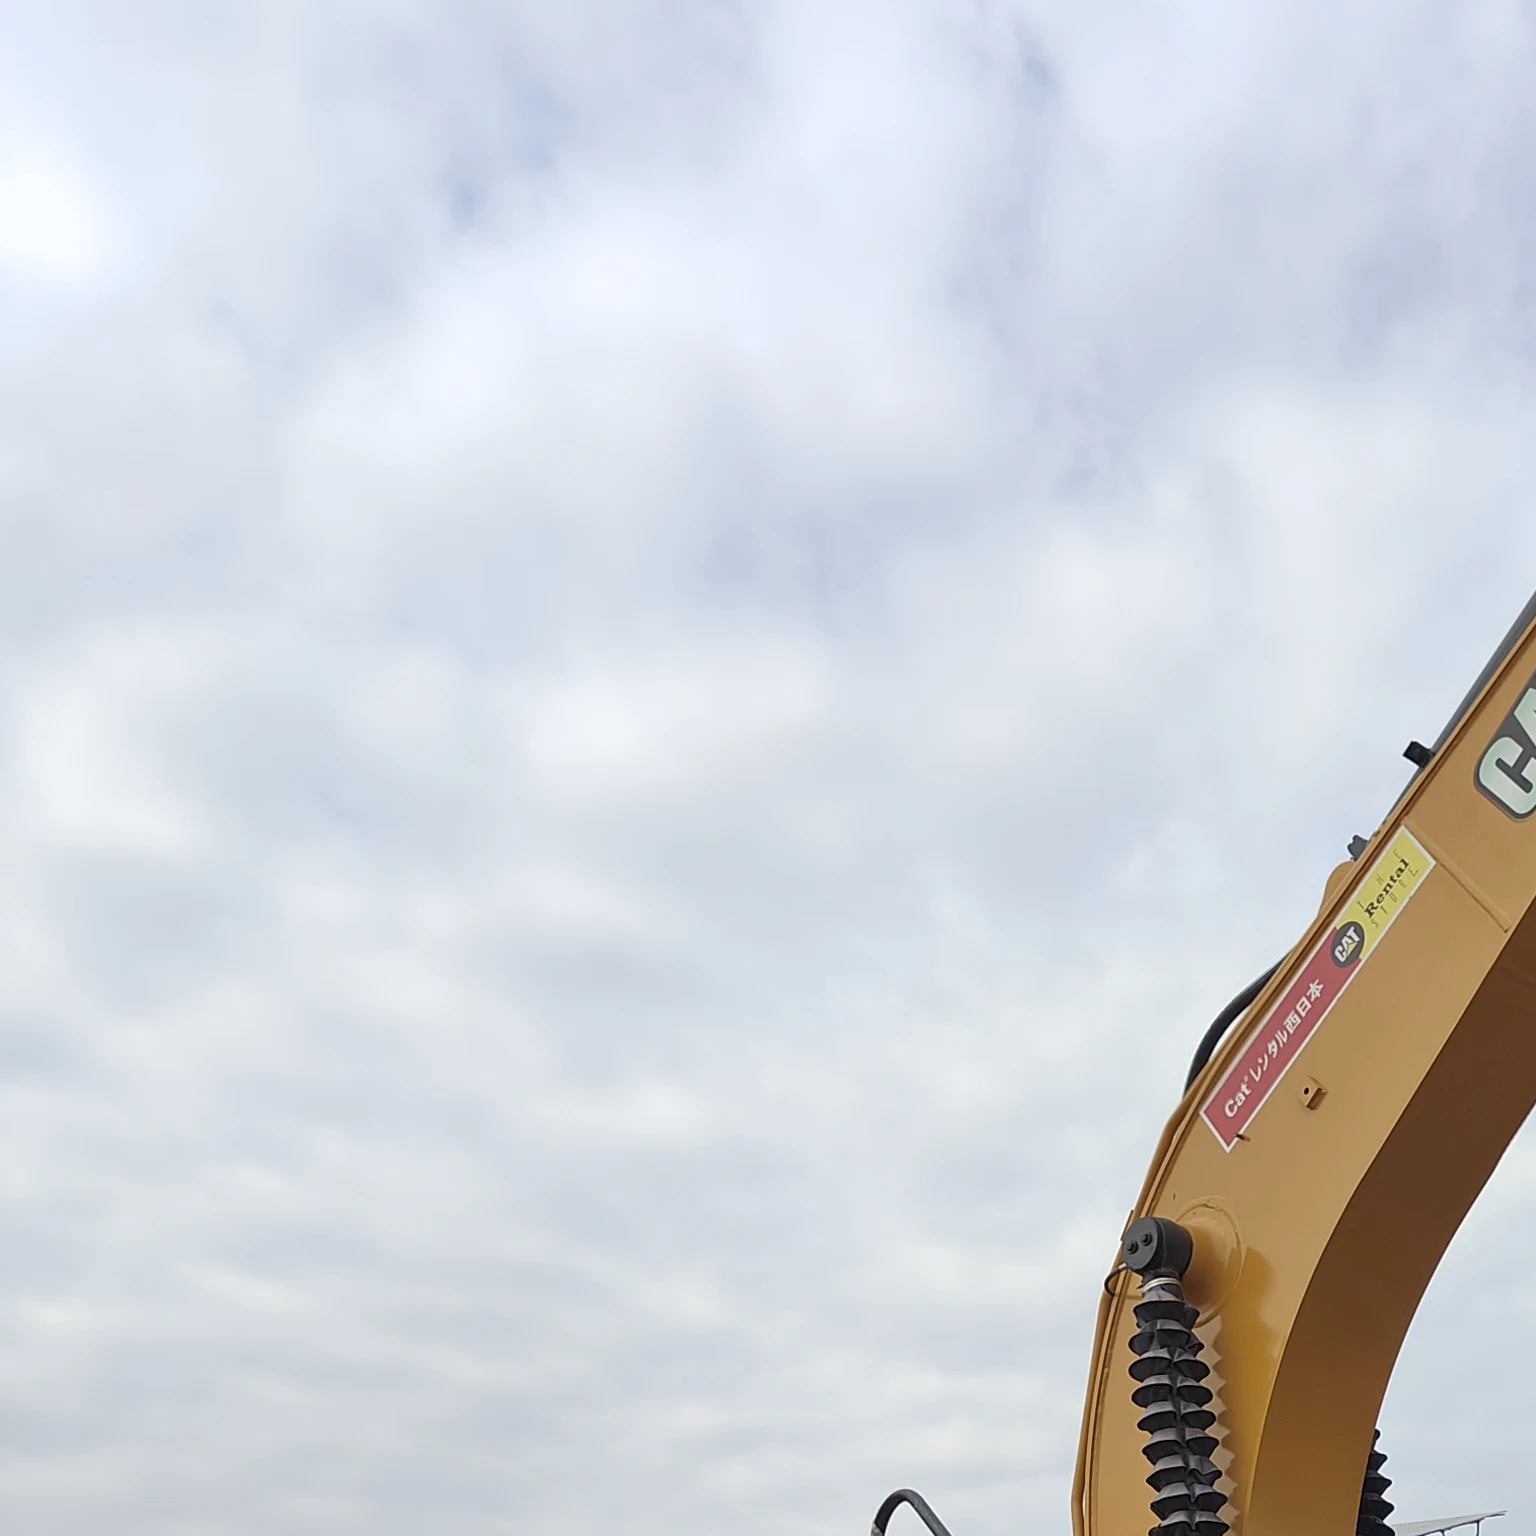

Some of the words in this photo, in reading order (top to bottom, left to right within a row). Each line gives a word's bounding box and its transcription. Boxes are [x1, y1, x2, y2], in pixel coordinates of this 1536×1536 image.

[1363, 857, 1410, 920] Rental
[1334, 926, 1360, 962] CAT
[1249, 978, 1324, 1082] レンタル西日本
